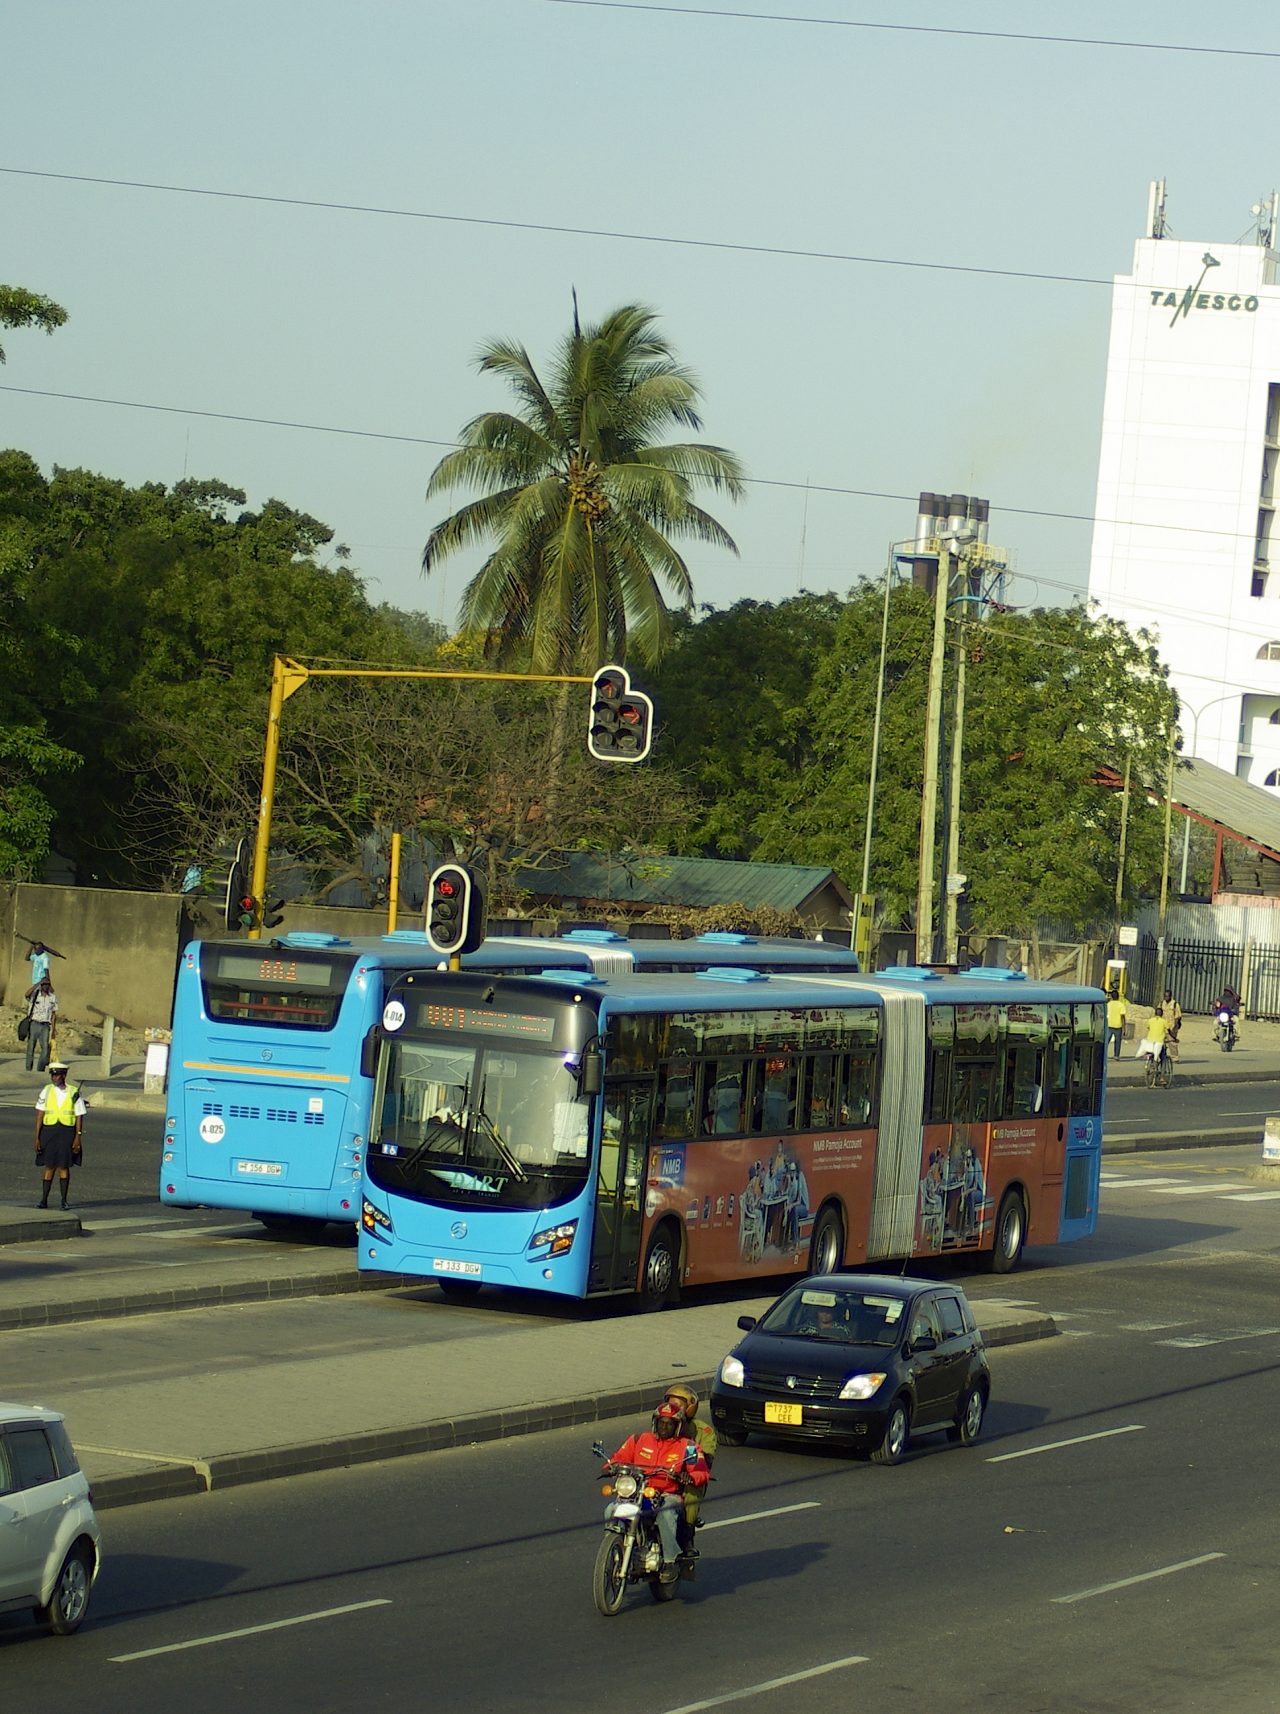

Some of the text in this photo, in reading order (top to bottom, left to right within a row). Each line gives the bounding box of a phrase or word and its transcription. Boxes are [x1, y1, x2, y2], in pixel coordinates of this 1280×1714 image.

[1150, 285, 1260, 318] TANESCO
[844, 1138, 863, 1149] Account
[662, 1159, 681, 1175] NMB
[450, 1172, 508, 1193] DART
